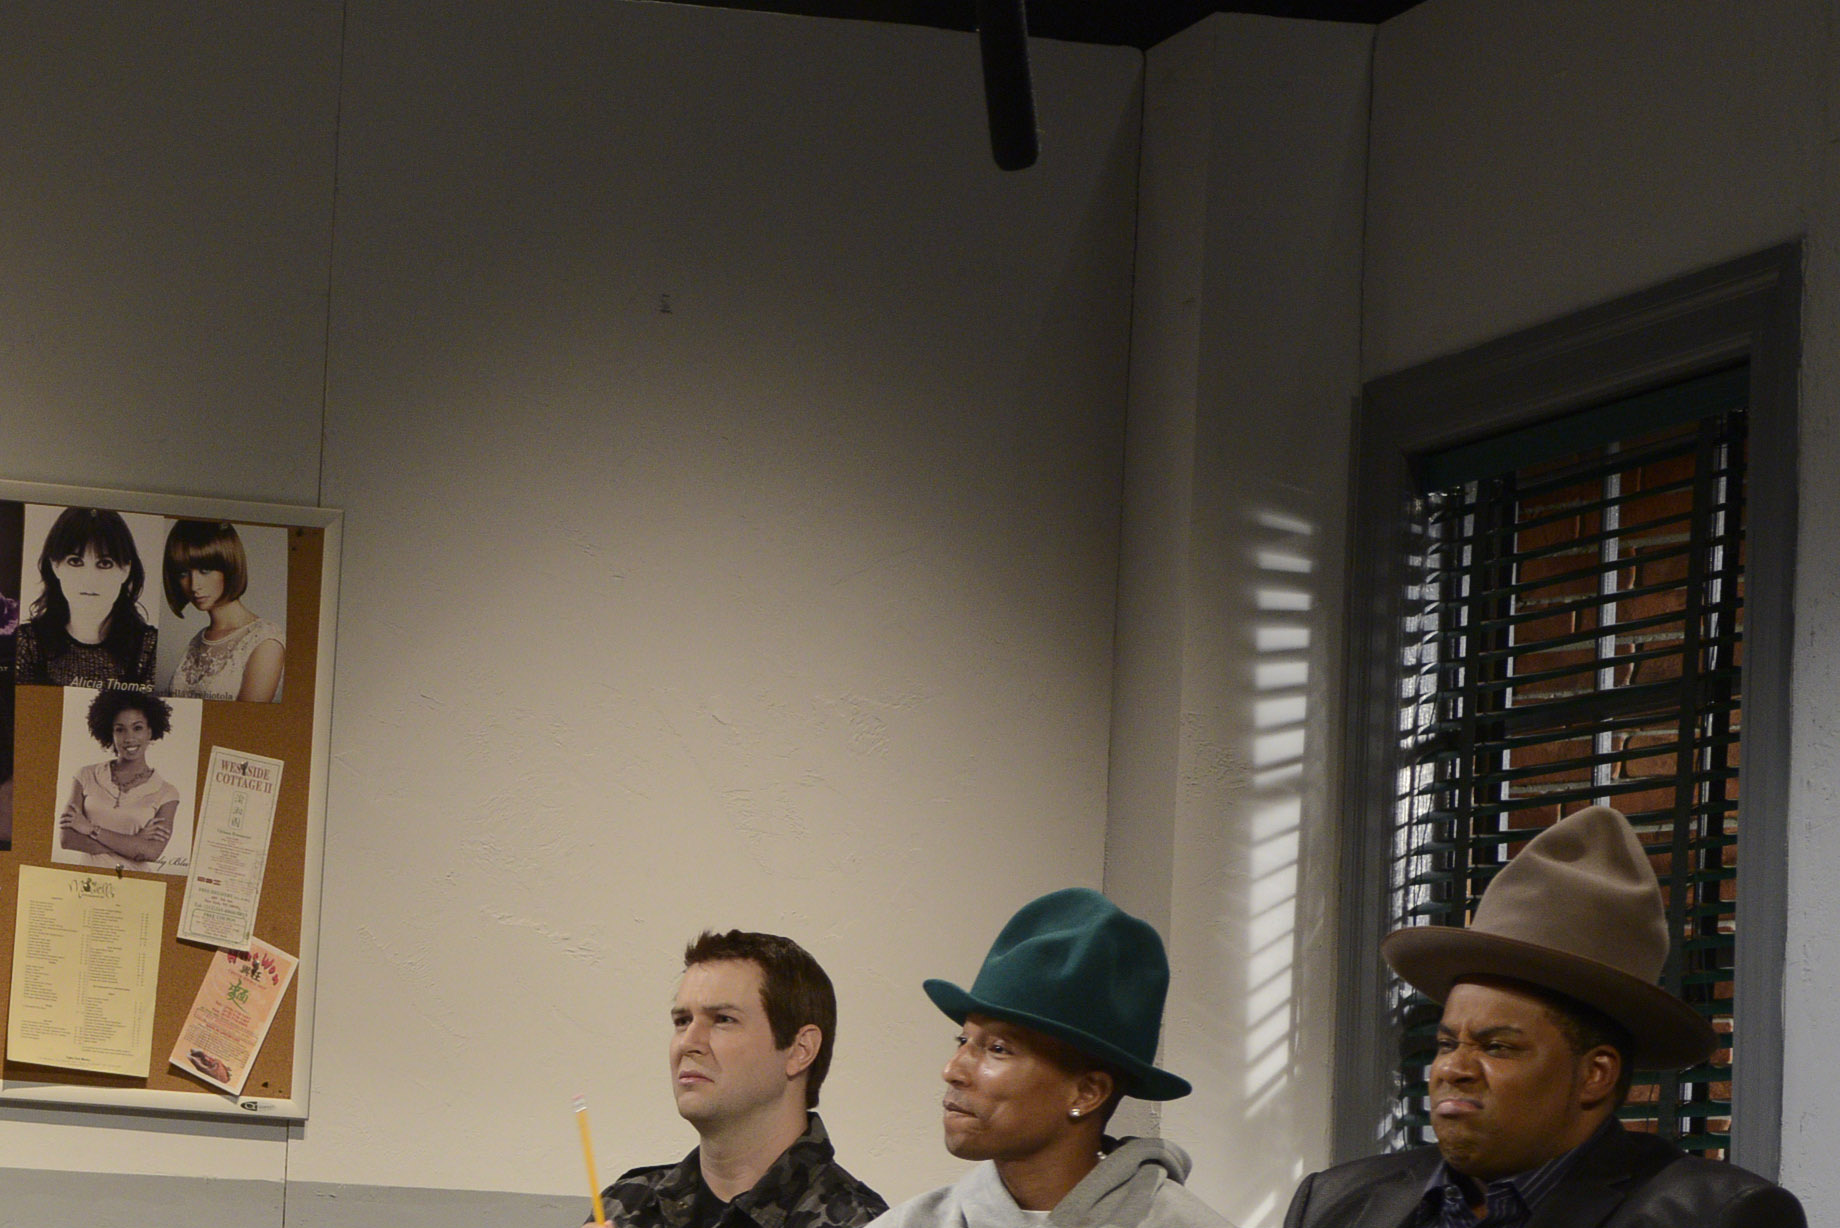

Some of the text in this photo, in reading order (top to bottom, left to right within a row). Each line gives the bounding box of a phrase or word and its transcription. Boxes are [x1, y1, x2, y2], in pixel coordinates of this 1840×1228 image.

[70, 676, 153, 692] Alicia Thomas
[216, 772, 273, 794] COTTAGE II
